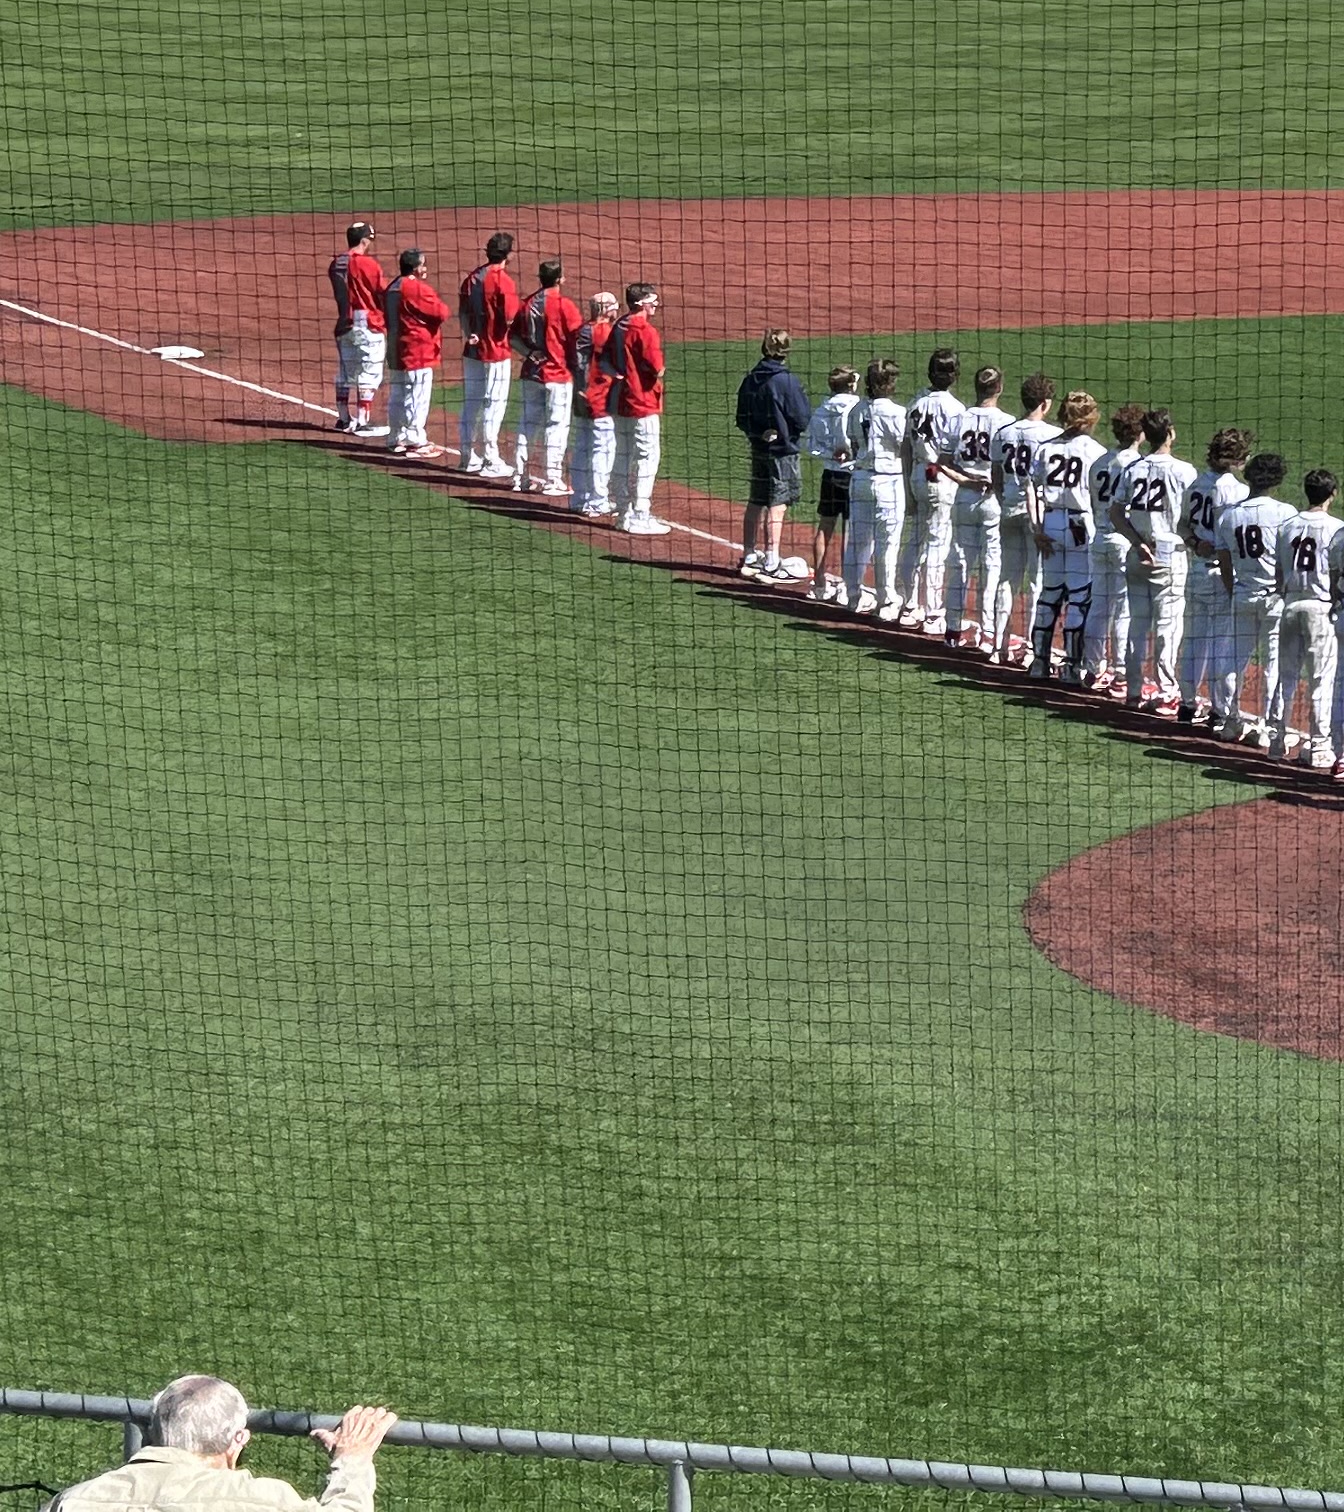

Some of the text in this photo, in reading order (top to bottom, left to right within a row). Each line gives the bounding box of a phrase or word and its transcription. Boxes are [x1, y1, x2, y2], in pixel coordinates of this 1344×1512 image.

[1046, 454, 1083, 488] 28
[1130, 478, 1167, 513] 22
[1189, 491, 1214, 531] 20
